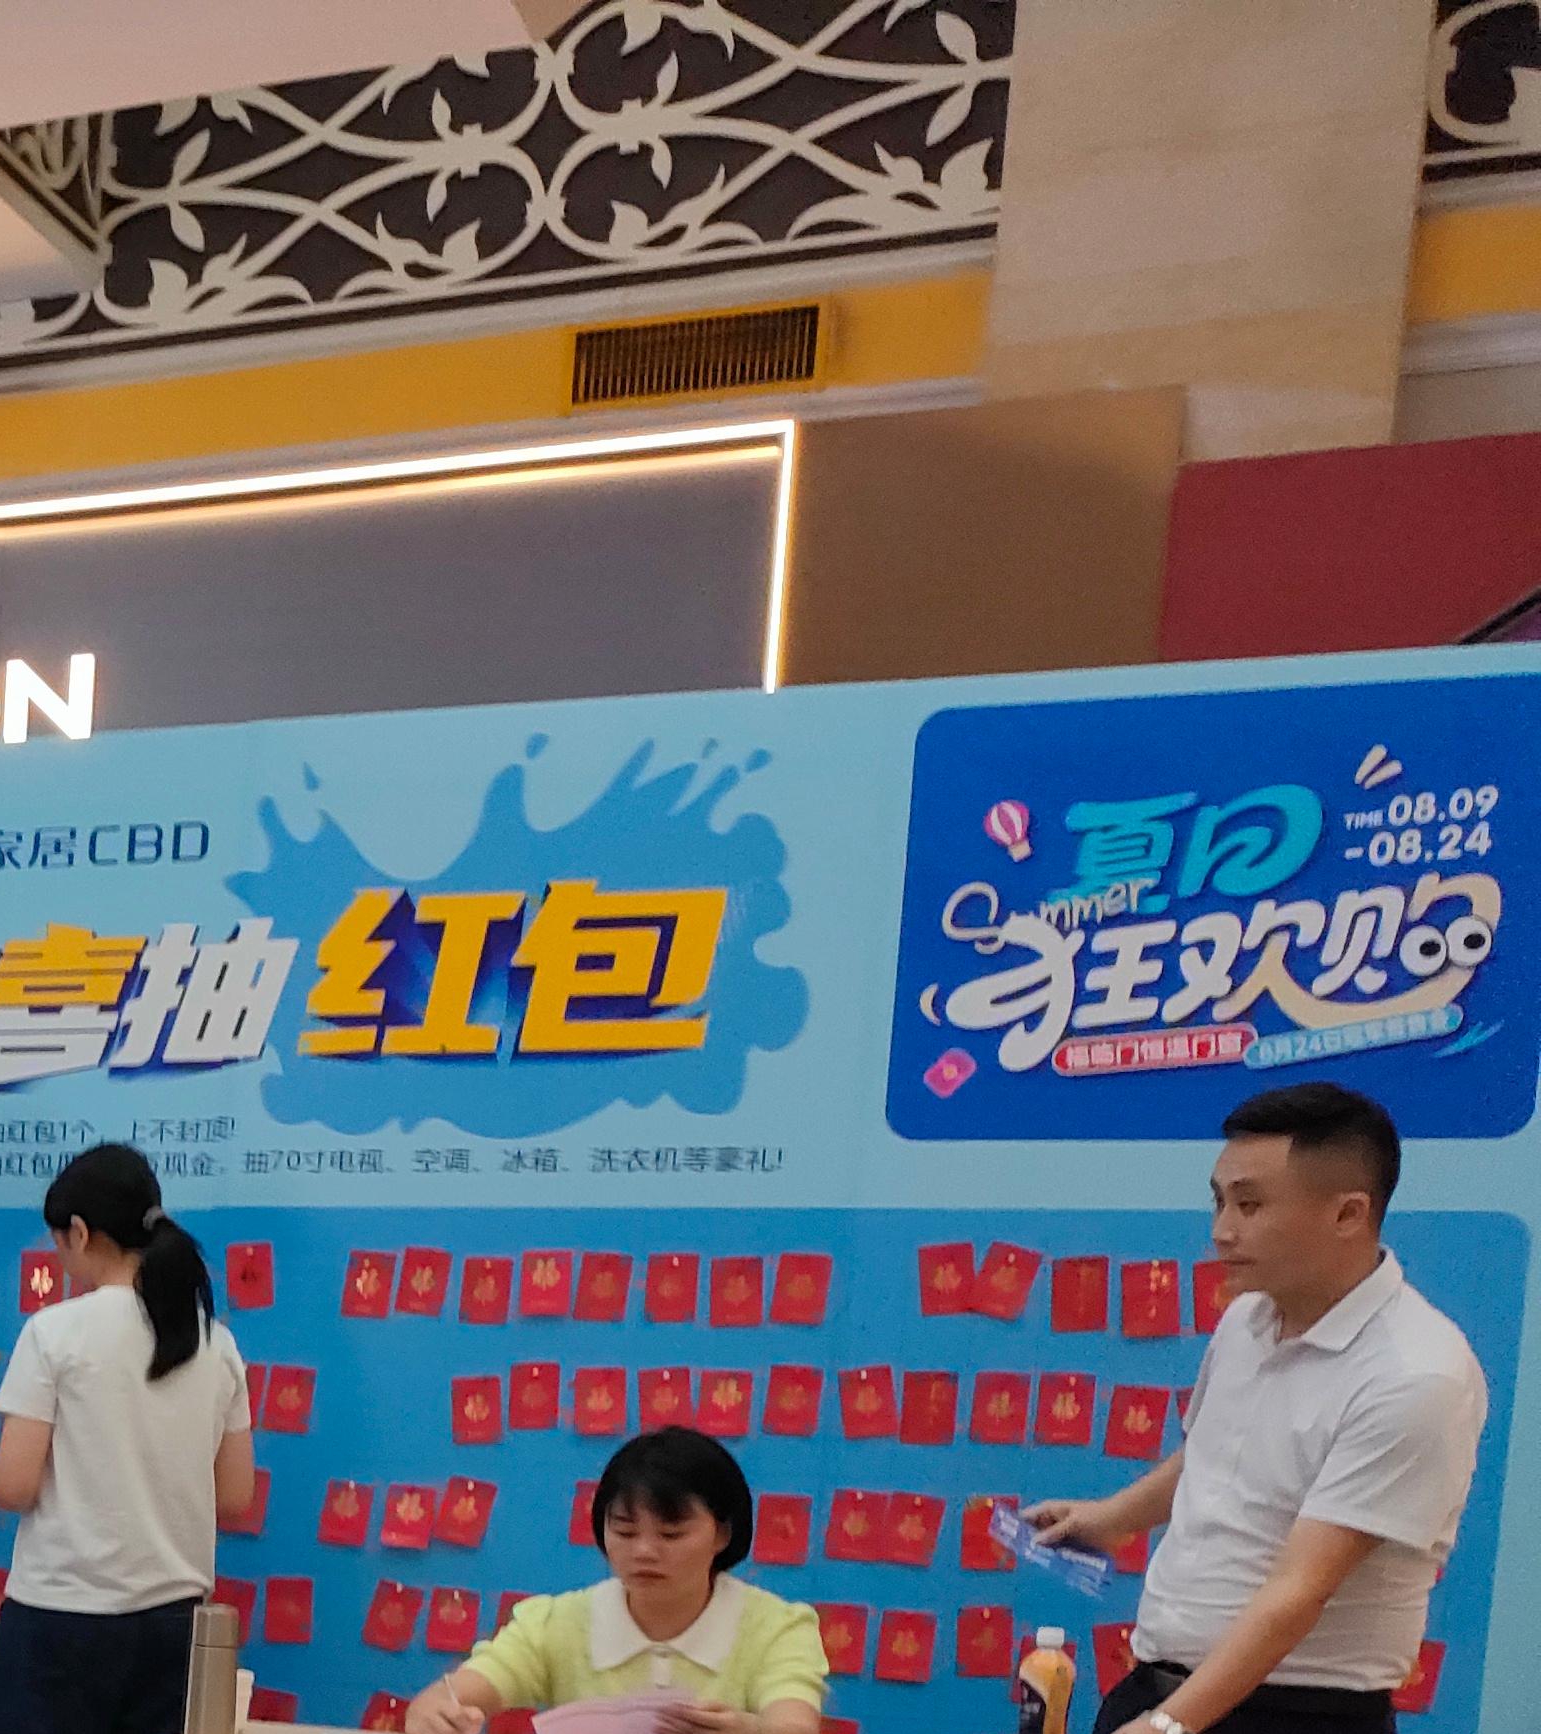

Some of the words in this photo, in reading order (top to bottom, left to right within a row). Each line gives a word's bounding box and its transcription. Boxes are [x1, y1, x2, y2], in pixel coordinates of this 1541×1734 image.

[1388, 784, 1500, 827] 08.09
[942, 877, 1159, 955] Smmer
[946, 872, 1503, 1071] 狂欢购
